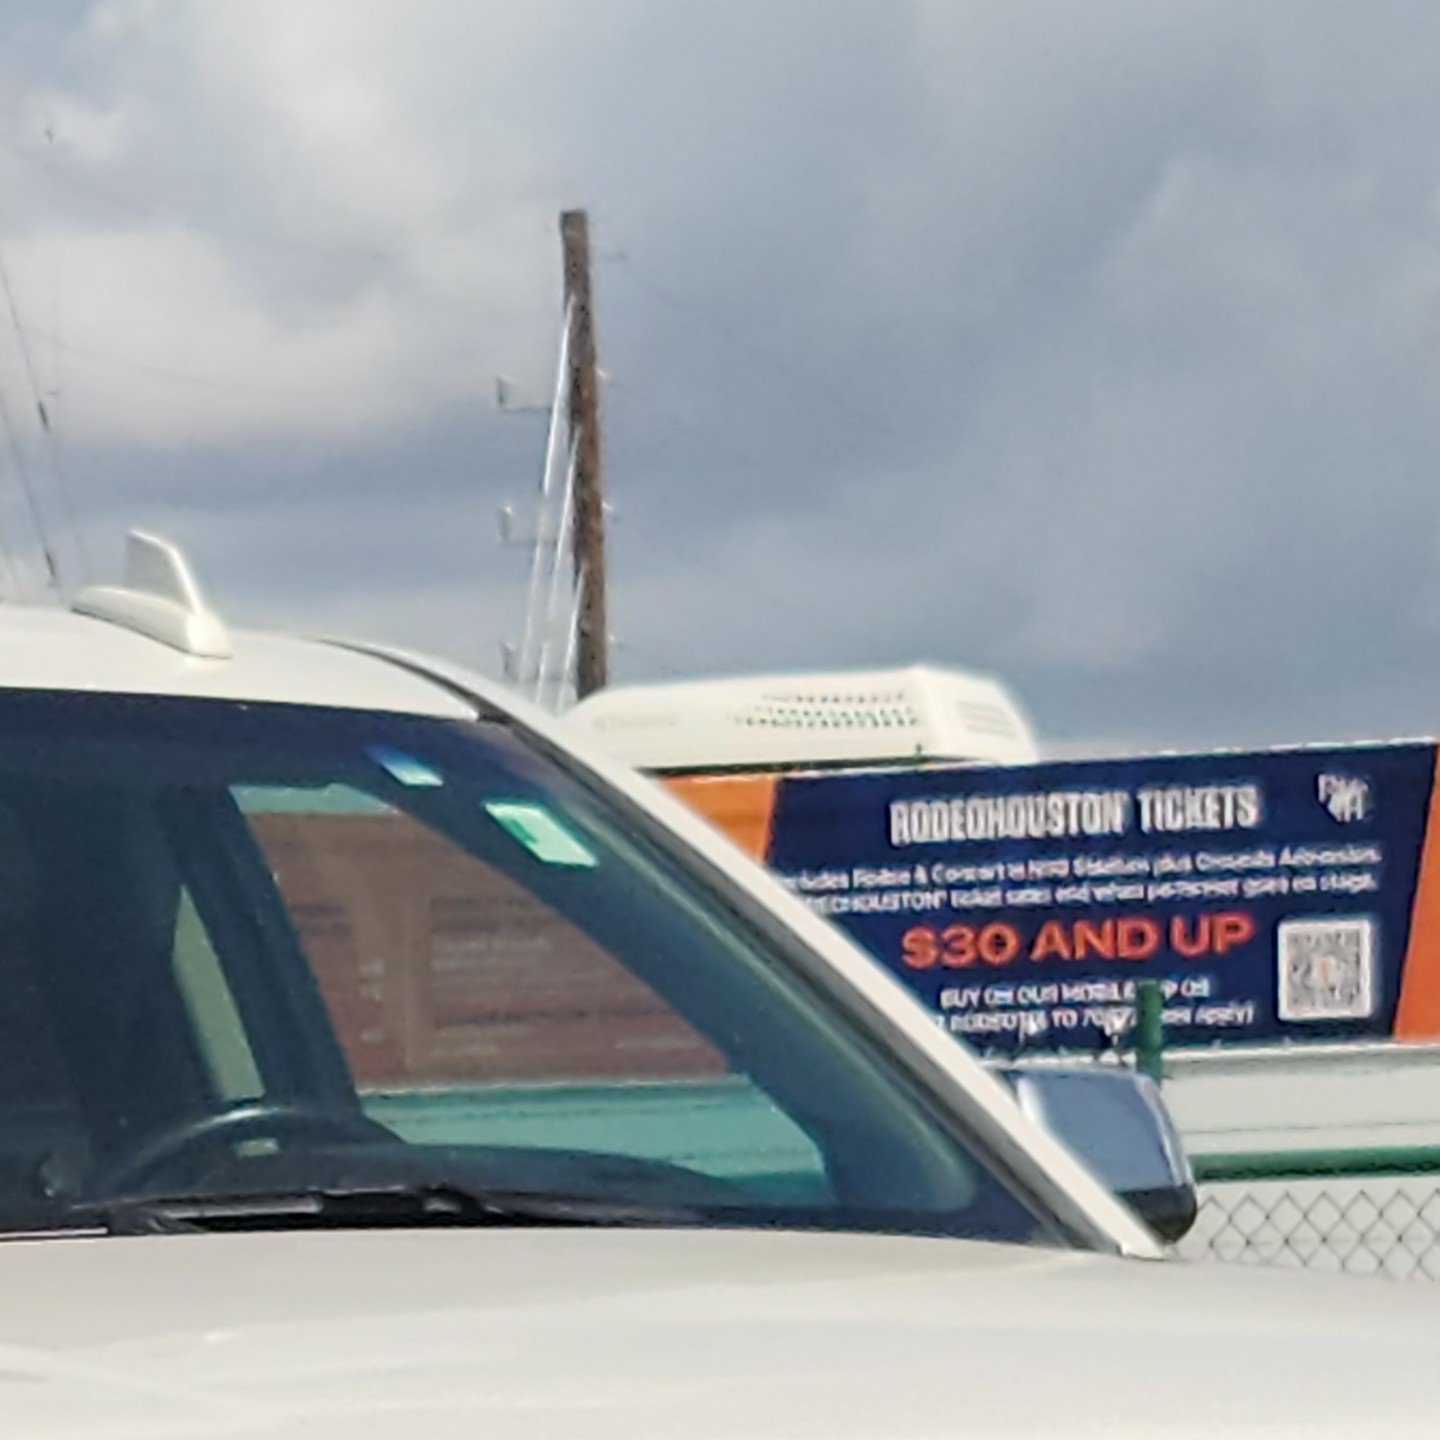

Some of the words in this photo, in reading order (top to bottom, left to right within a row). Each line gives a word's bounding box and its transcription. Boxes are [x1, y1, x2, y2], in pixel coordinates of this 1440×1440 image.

[1137, 787, 1259, 832] TICKETS
[902, 924, 1019, 969] $30
[1033, 919, 1160, 961] AND
[1172, 914, 1255, 955] UP
